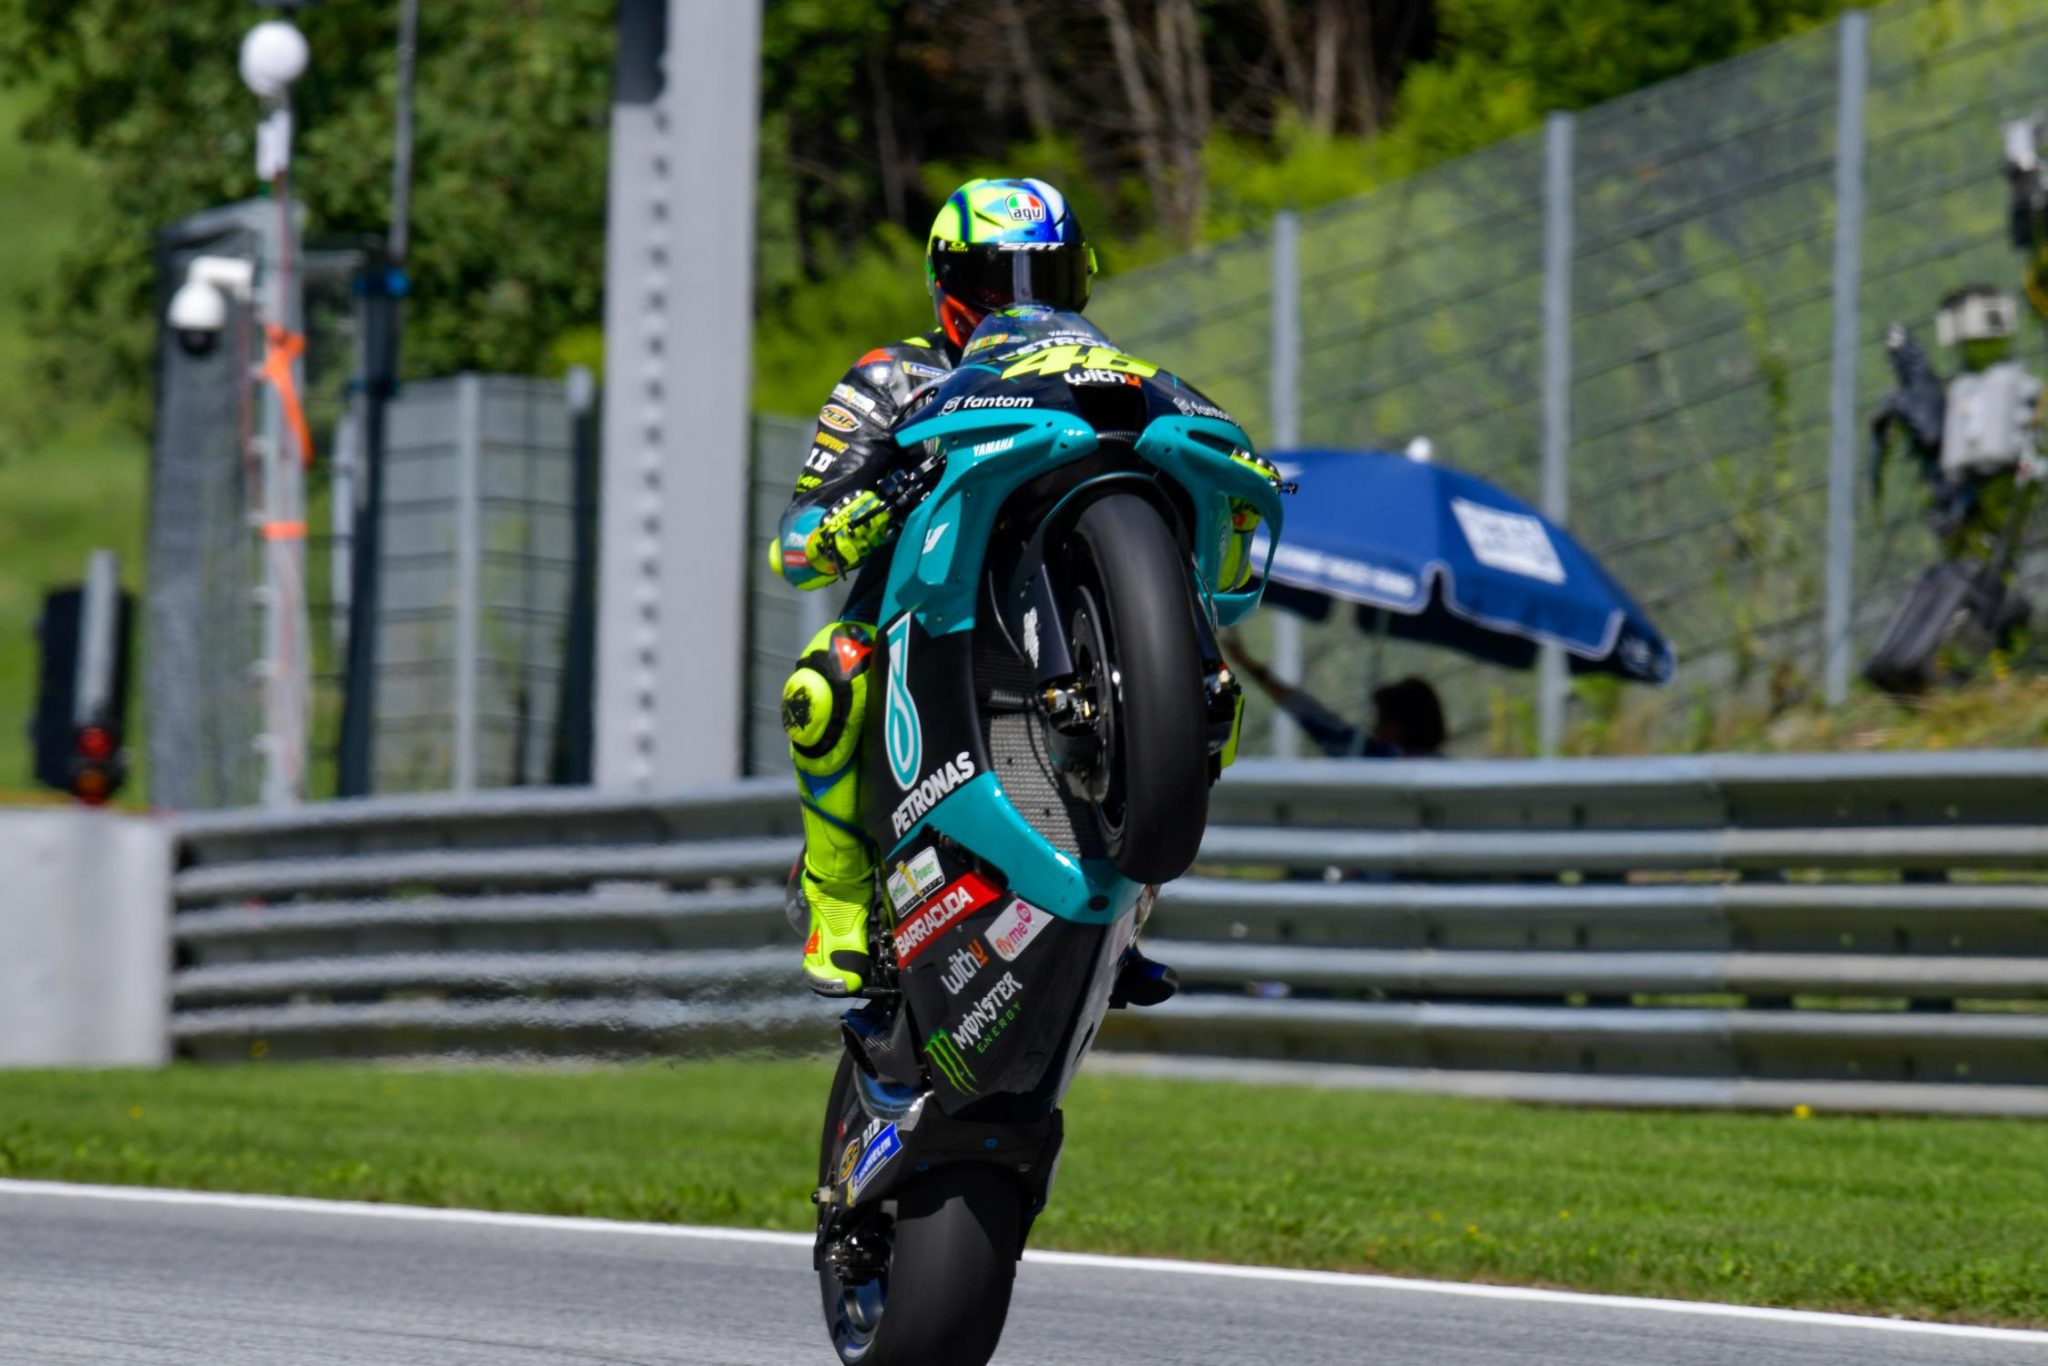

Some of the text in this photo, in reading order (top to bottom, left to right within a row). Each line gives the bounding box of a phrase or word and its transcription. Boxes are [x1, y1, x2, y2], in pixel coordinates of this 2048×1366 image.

[1014, 207, 1040, 221] agv
[1001, 344, 1159, 379] 46
[963, 395, 1034, 409] fantom
[973, 437, 1014, 457] YAMAHA
[891, 751, 975, 839] PETRONAS
[895, 886, 974, 957] BARRACUDA
[952, 971, 1023, 1050] MONSTER
[976, 1001, 1023, 1053] ENERGY
